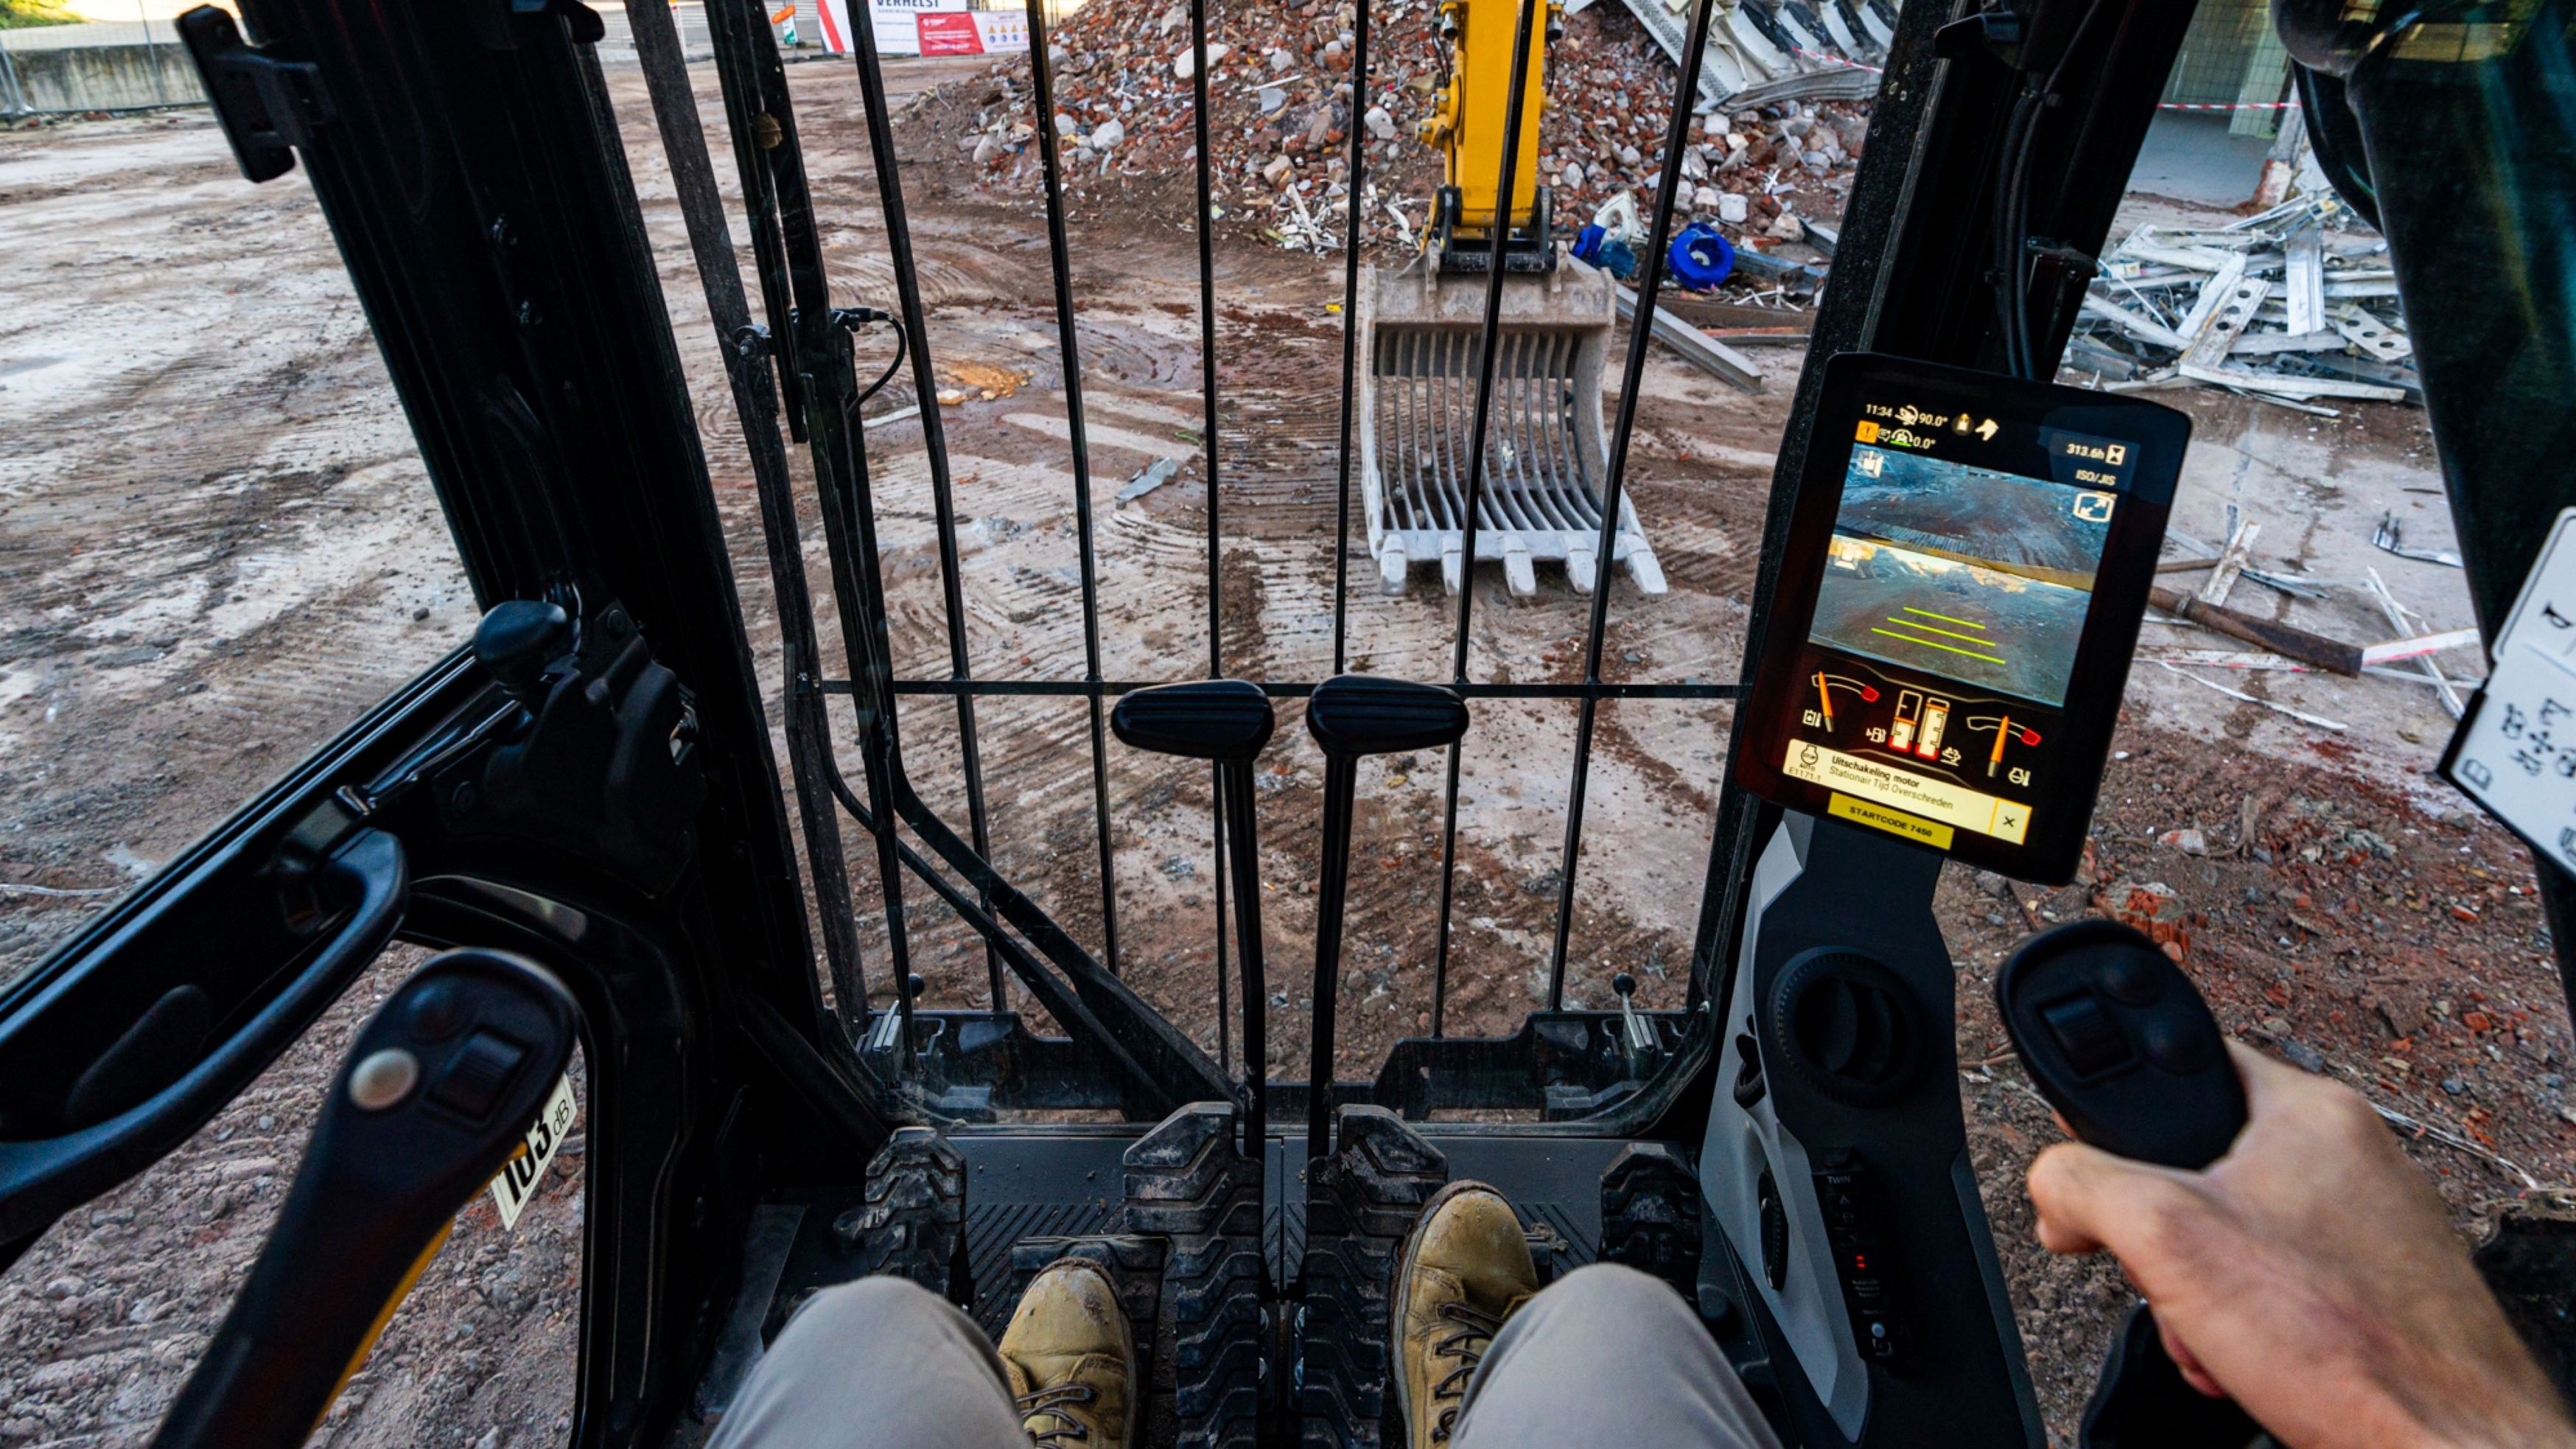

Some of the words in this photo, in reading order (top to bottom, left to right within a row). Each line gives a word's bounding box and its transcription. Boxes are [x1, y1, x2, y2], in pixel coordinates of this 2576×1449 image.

[1866, 404, 1893, 418] 11:34
[2075, 469, 2116, 486] ISO/JIS
[1829, 765, 1871, 786] Stationair
[1874, 778, 1890, 792] Tijd
[1891, 785, 1954, 810] Overschreden
[1831, 755, 1891, 782] Uitschakeling
[1893, 774, 1920, 789] motor
[1849, 806, 1908, 830] STARTCODE
[1910, 824, 1933, 837] 7450
[553, 1098, 570, 1136] dB
